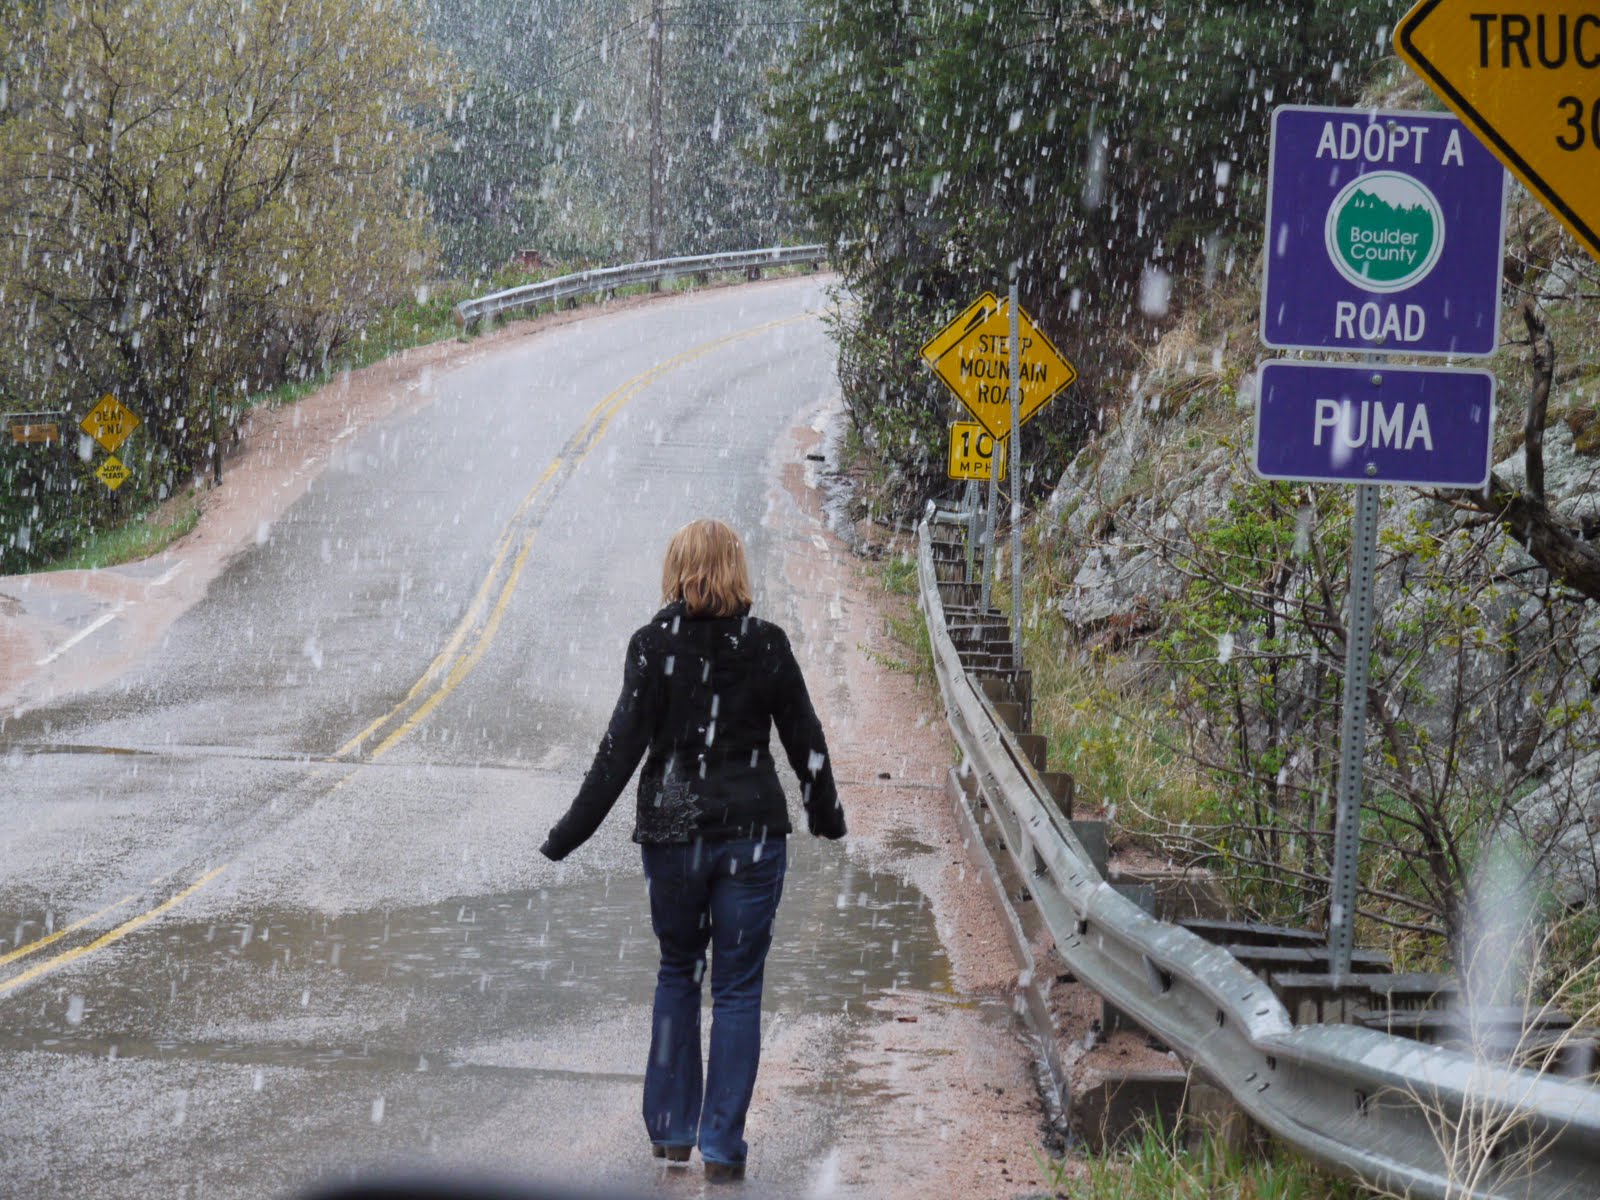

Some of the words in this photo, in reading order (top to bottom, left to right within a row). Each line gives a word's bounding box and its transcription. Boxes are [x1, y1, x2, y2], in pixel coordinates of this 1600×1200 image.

[1470, 14, 1600, 69] TRUC
[1315, 121, 1429, 164] ADOPT
[1441, 129, 1464, 166] A
[1350, 226, 1419, 245] Boulder
[1350, 243, 1417, 265] County
[1334, 301, 1426, 341] ROAD
[979, 334, 1032, 355] STEP
[960, 357, 1047, 382] MOUNAIN
[1313, 399, 1433, 450] PUMA
